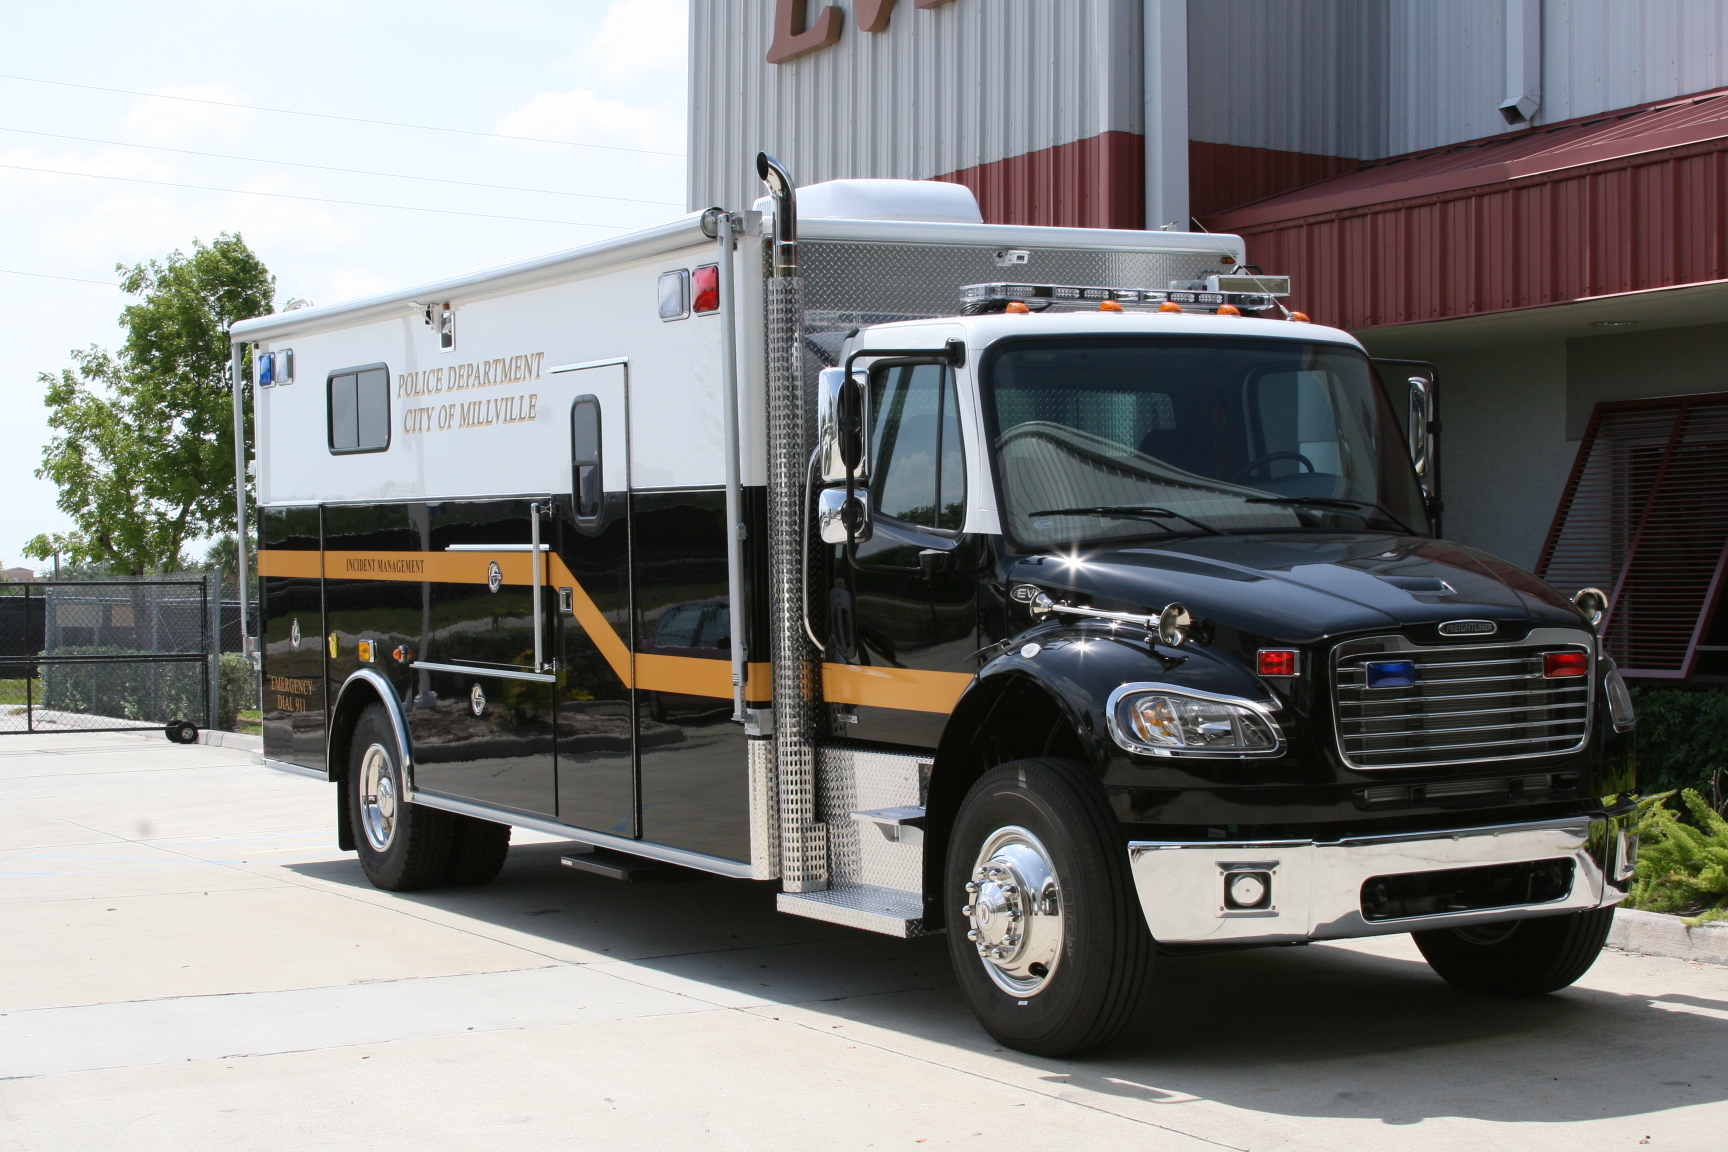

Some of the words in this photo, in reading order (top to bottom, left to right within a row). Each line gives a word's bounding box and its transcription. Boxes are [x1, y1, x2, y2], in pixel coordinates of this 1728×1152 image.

[397, 368, 443, 399] POLICE
[446, 352, 544, 392] DEPARTMENT
[404, 407, 435, 434] CITY
[438, 404, 456, 431] OF
[458, 394, 537, 429] MILLVILLE
[346, 559, 375, 572] INCIDENT
[378, 559, 424, 573] MANAGEMENT
[1017, 588, 1037, 598] EV
[1446, 623, 1492, 632] FREIGHTLINER
[271, 675, 312, 695] EMERGENCY
[277, 695, 293, 711] DIAL
[295, 697, 306, 713] 911
